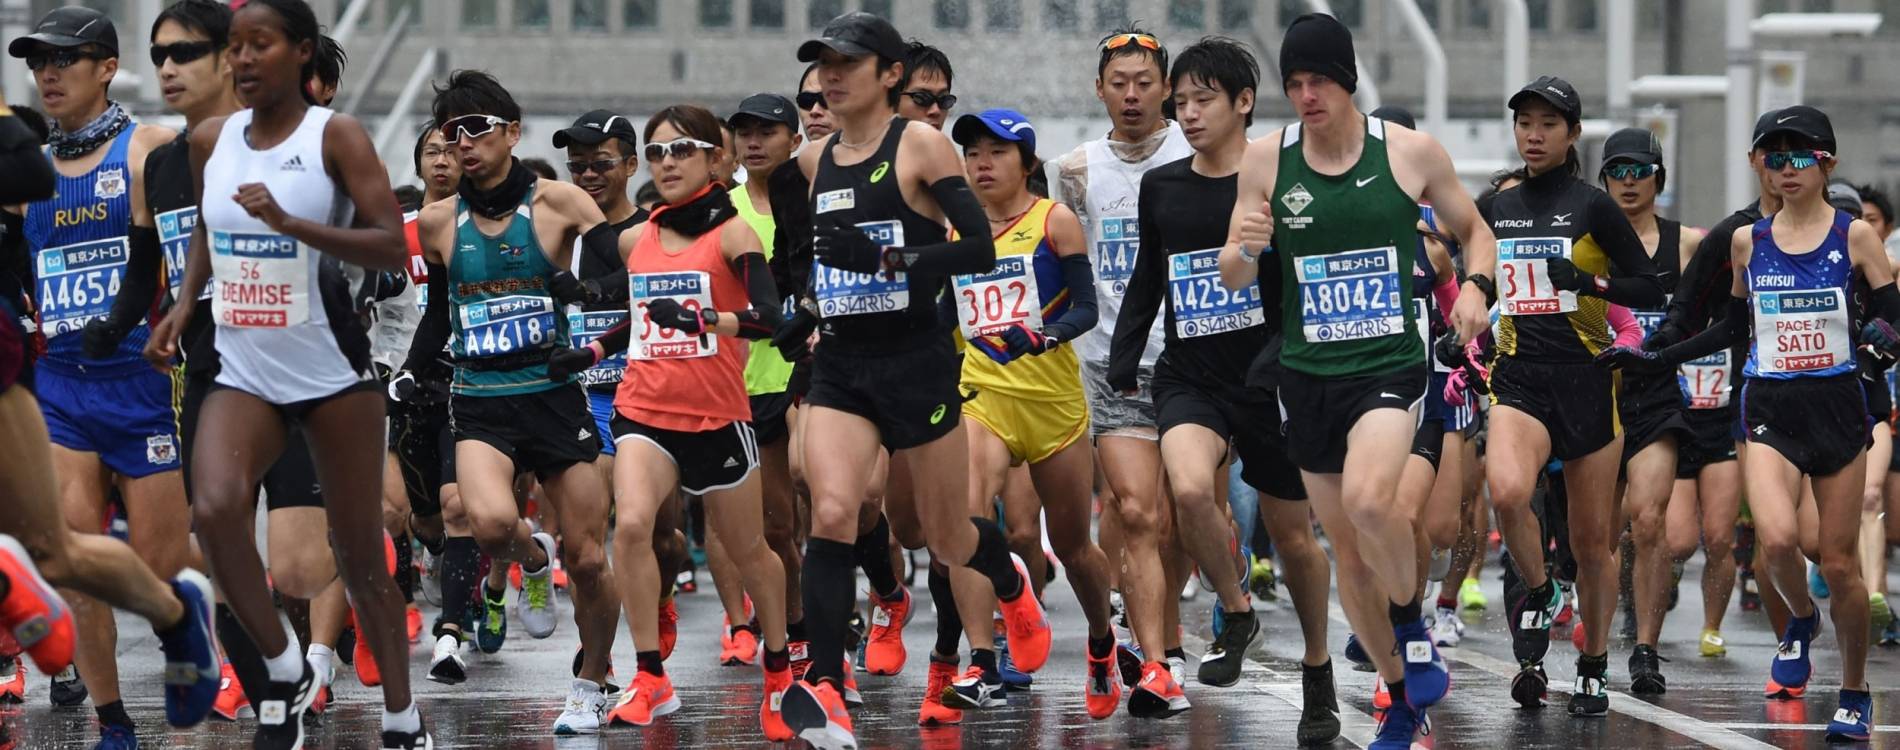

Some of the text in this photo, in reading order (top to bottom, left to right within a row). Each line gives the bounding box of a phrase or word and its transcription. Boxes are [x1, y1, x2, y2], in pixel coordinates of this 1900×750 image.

[55, 202, 108, 228] RUNS
[1494, 219, 1533, 228] HITACHI
[864, 229, 889, 240] トロ
[67, 245, 121, 265] 東京メトロ
[234, 239, 293, 253] 東京メトロ
[1515, 243, 1560, 254] 東京メトロ
[164, 241, 186, 278] A4
[1100, 242, 1140, 272] A47
[1192, 256, 1219, 270] 東京
[1328, 256, 1385, 272] 東京メトロ
[240, 261, 261, 280] 56
[975, 262, 1022, 278] メトロ
[649, 279, 697, 292] 東京メトロ
[1502, 263, 1559, 298] 31
[1755, 275, 1795, 287] SEKISUI
[41, 268, 121, 313] A4654
[222, 281, 292, 305] DEMISE
[1302, 278, 1387, 317] A8042
[490, 299, 541, 316] 東京メトロ
[962, 281, 1030, 326] 302
[1783, 296, 1834, 309] 東京メトロ
[1776, 318, 1828, 332] PACE 27
[466, 317, 543, 357] A4618
[1777, 332, 1826, 353] SATO
[1696, 368, 1724, 395] 12
